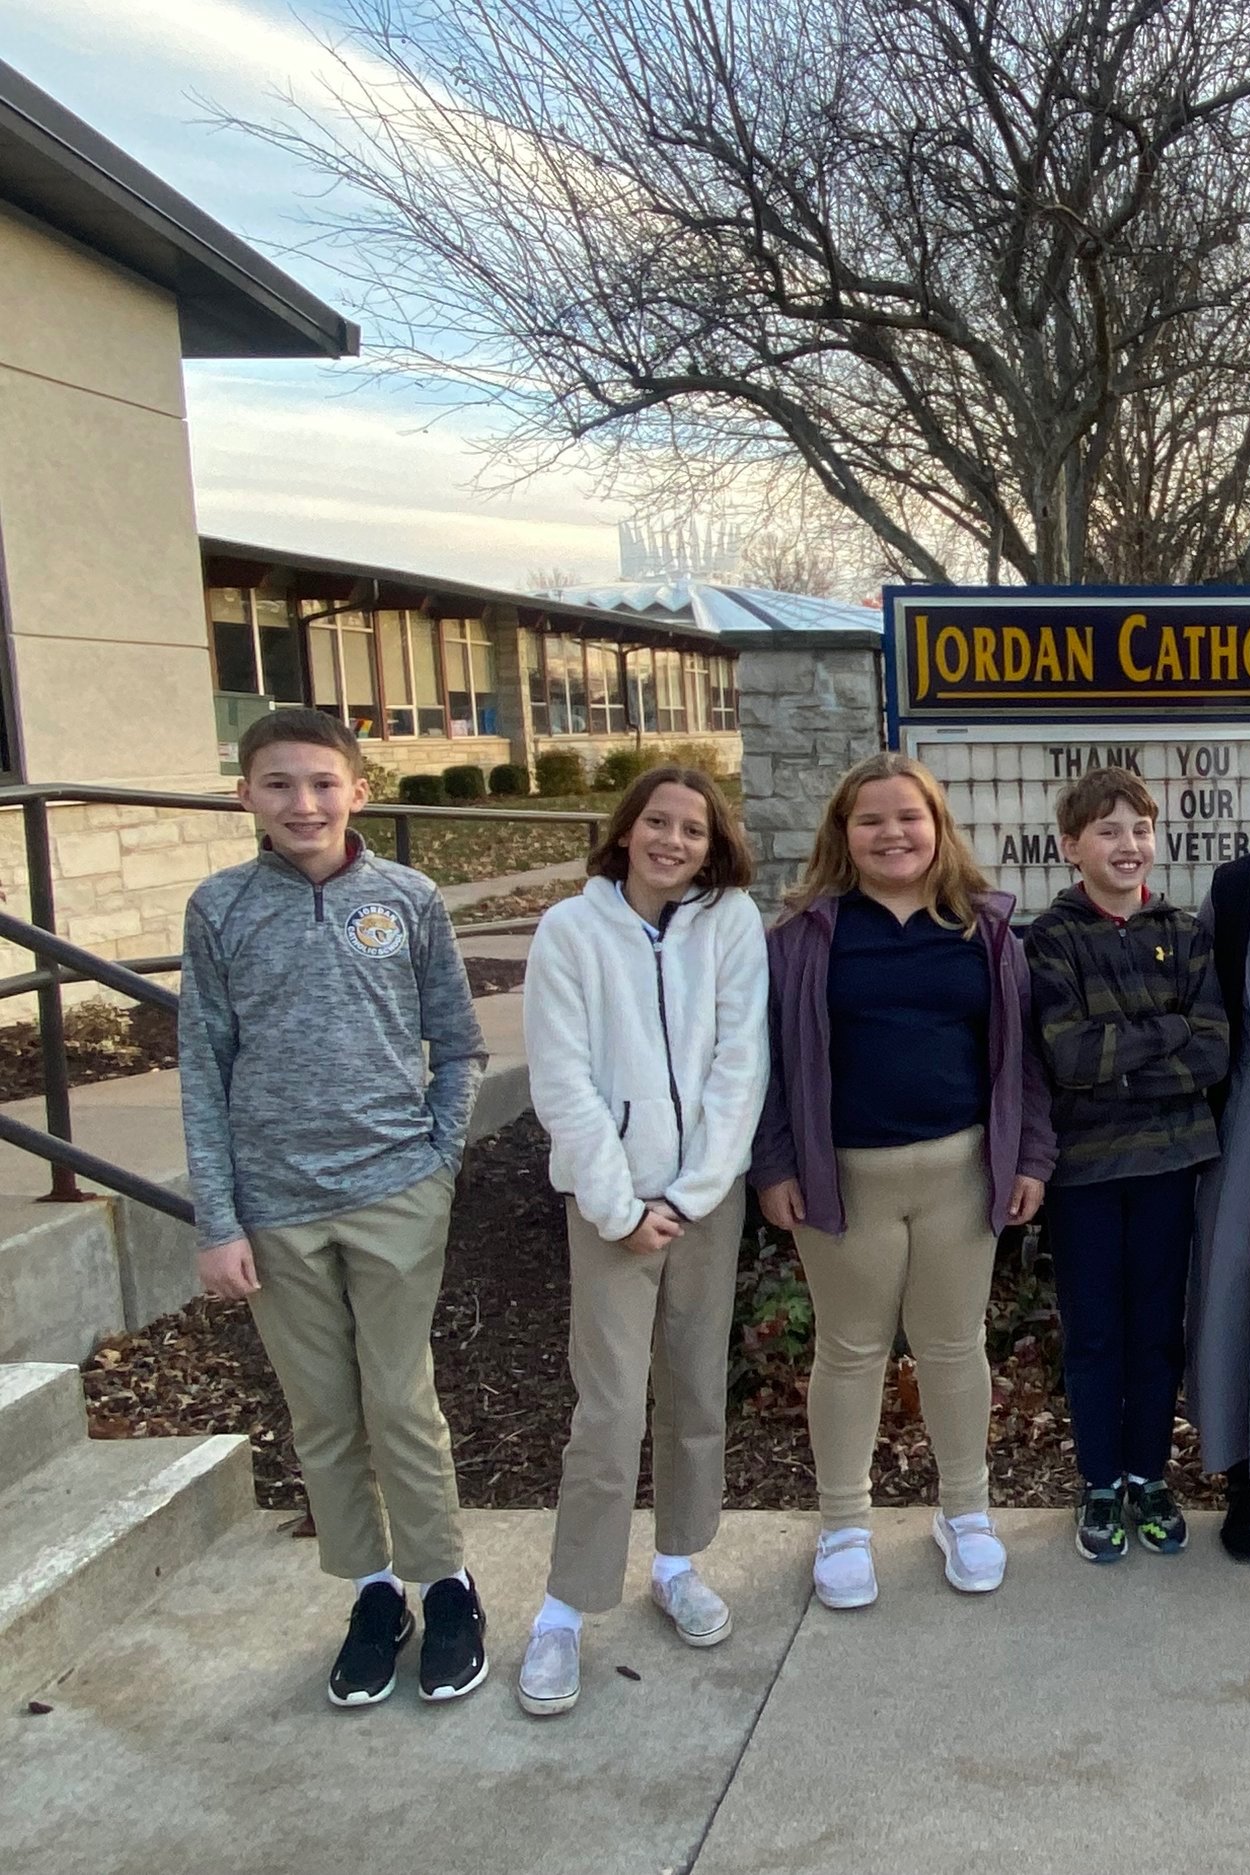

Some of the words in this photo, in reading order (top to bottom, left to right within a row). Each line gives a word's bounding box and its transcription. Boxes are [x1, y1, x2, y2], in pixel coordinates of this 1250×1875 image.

[915, 615, 1094, 700] JORDAN
[1049, 747, 1142, 777] THANK
[1176, 746, 1230, 777] YOU
[1180, 789, 1234, 819] OUR
[1001, 834, 1071, 864] AMA
[358, 906, 398, 923] JORDAN
